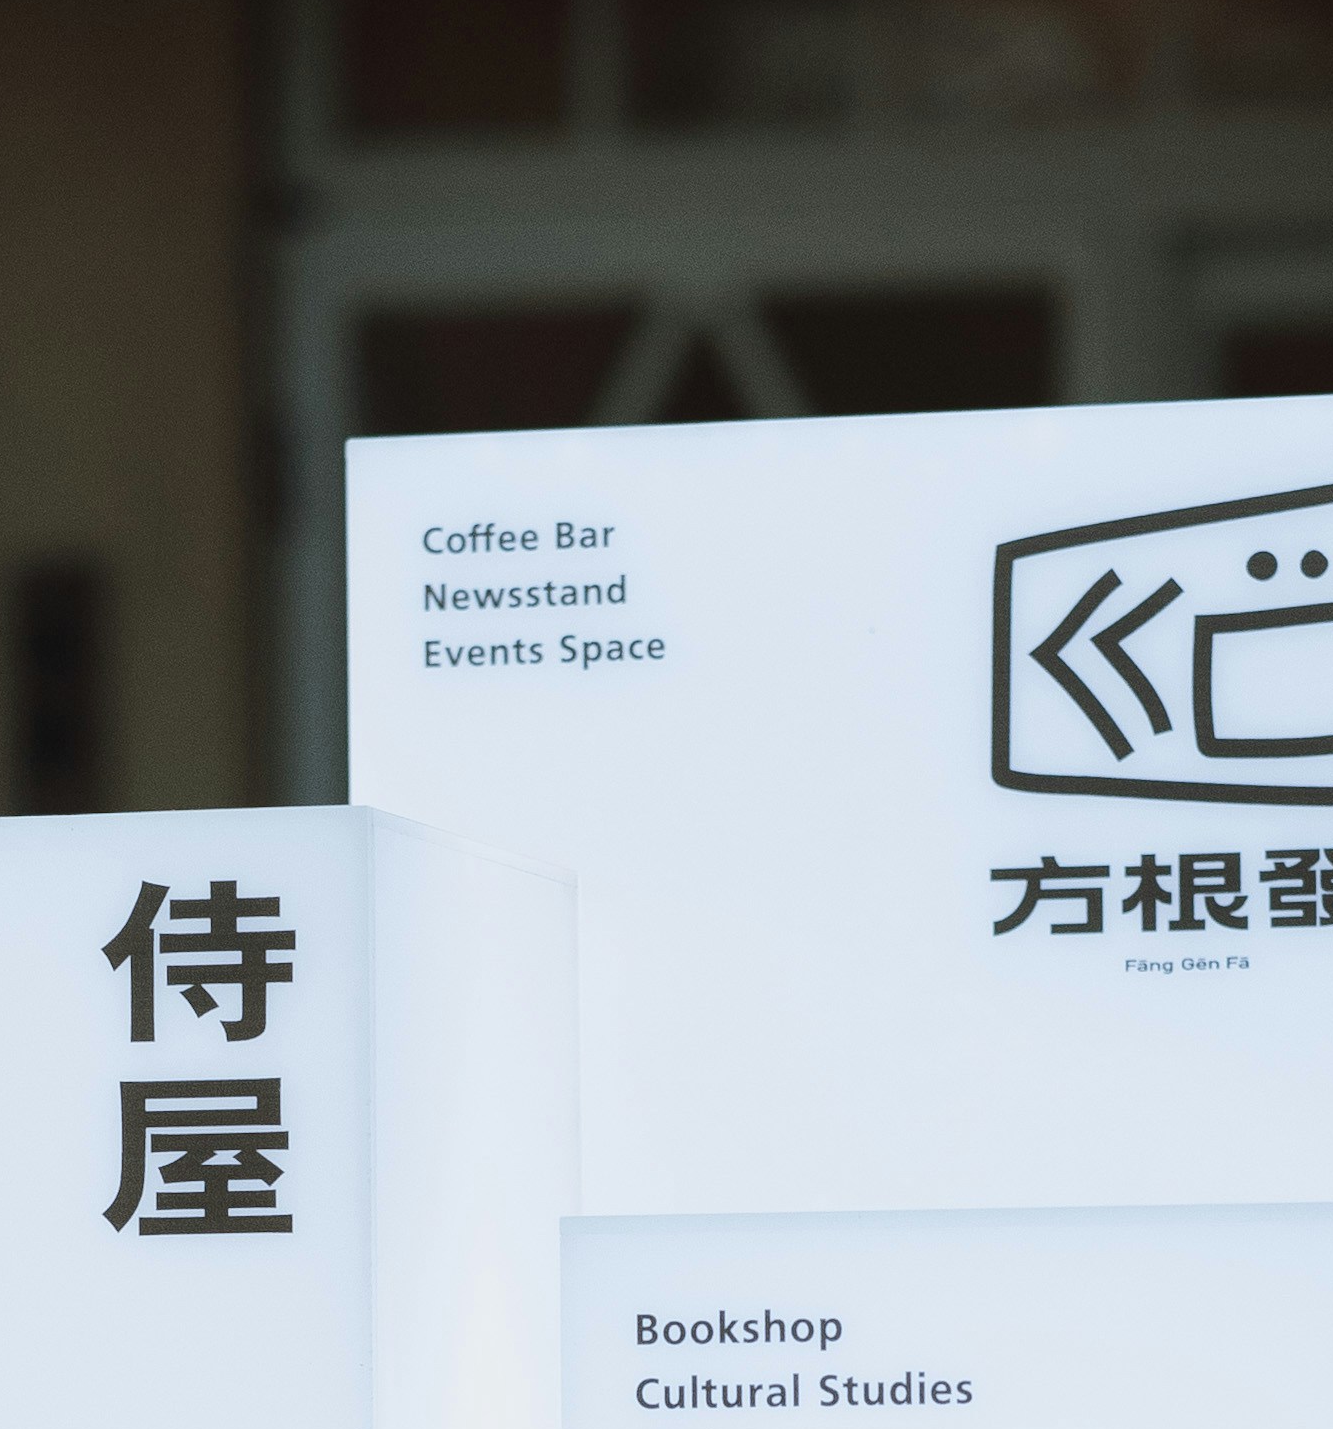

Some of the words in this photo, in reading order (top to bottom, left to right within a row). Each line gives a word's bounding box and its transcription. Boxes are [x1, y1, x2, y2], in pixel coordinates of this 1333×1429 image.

[422, 521, 539, 556] Coffee
[556, 520, 616, 550] Bar
[423, 574, 627, 612] Newsstand
[423, 638, 544, 669] Events
[559, 633, 666, 671] Space
[99, 879, 297, 1237] 侍屋
[635, 1309, 843, 1352] Bookshop
[635, 1372, 801, 1410] Cultural
[818, 1370, 974, 1408] Studies
